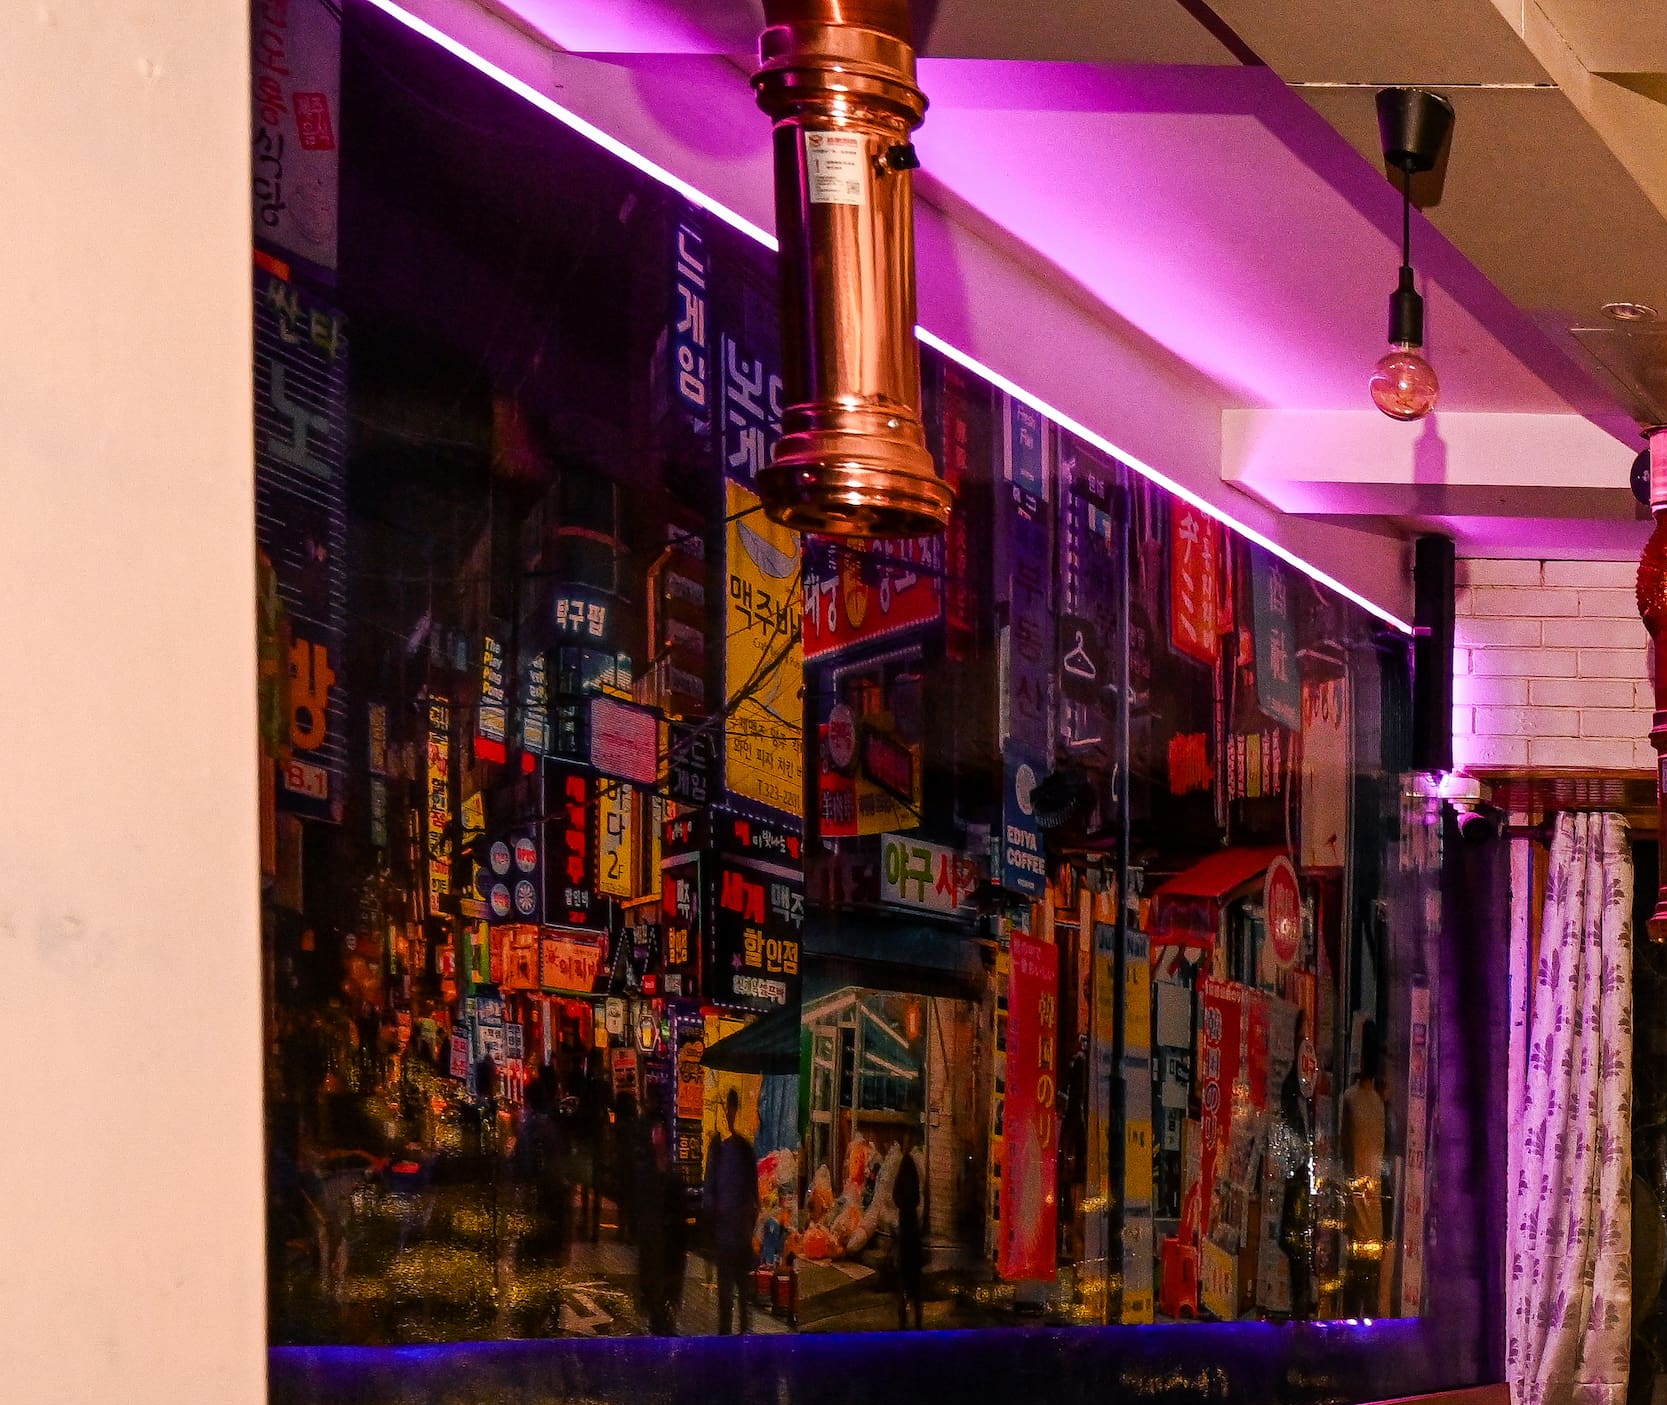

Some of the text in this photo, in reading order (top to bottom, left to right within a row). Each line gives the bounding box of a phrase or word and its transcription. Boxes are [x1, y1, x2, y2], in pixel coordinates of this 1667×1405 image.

[1007, 824, 1038, 851] EDIYA
[1006, 846, 1046, 876] COFFEE
[743, 926, 799, 976] 할인점
